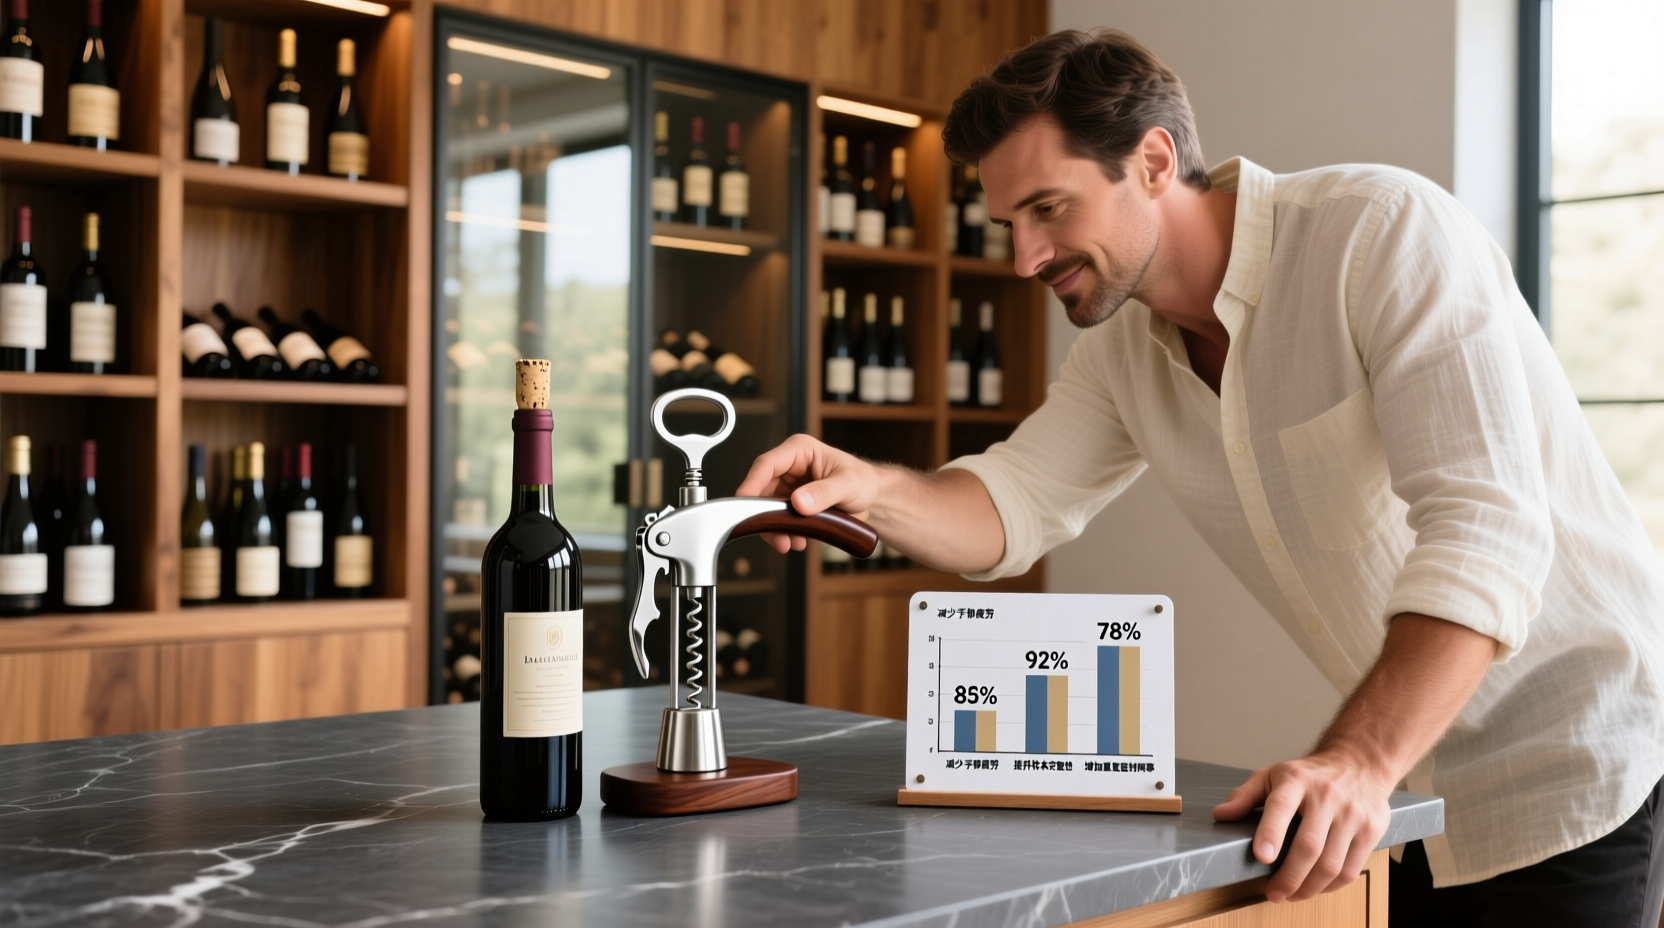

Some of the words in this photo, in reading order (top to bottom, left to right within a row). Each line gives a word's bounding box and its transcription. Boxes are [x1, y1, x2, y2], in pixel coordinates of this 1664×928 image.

[1097, 622, 1141, 640] 78%
[1025, 651, 1069, 670] 92%
[954, 685, 998, 705] 85%
